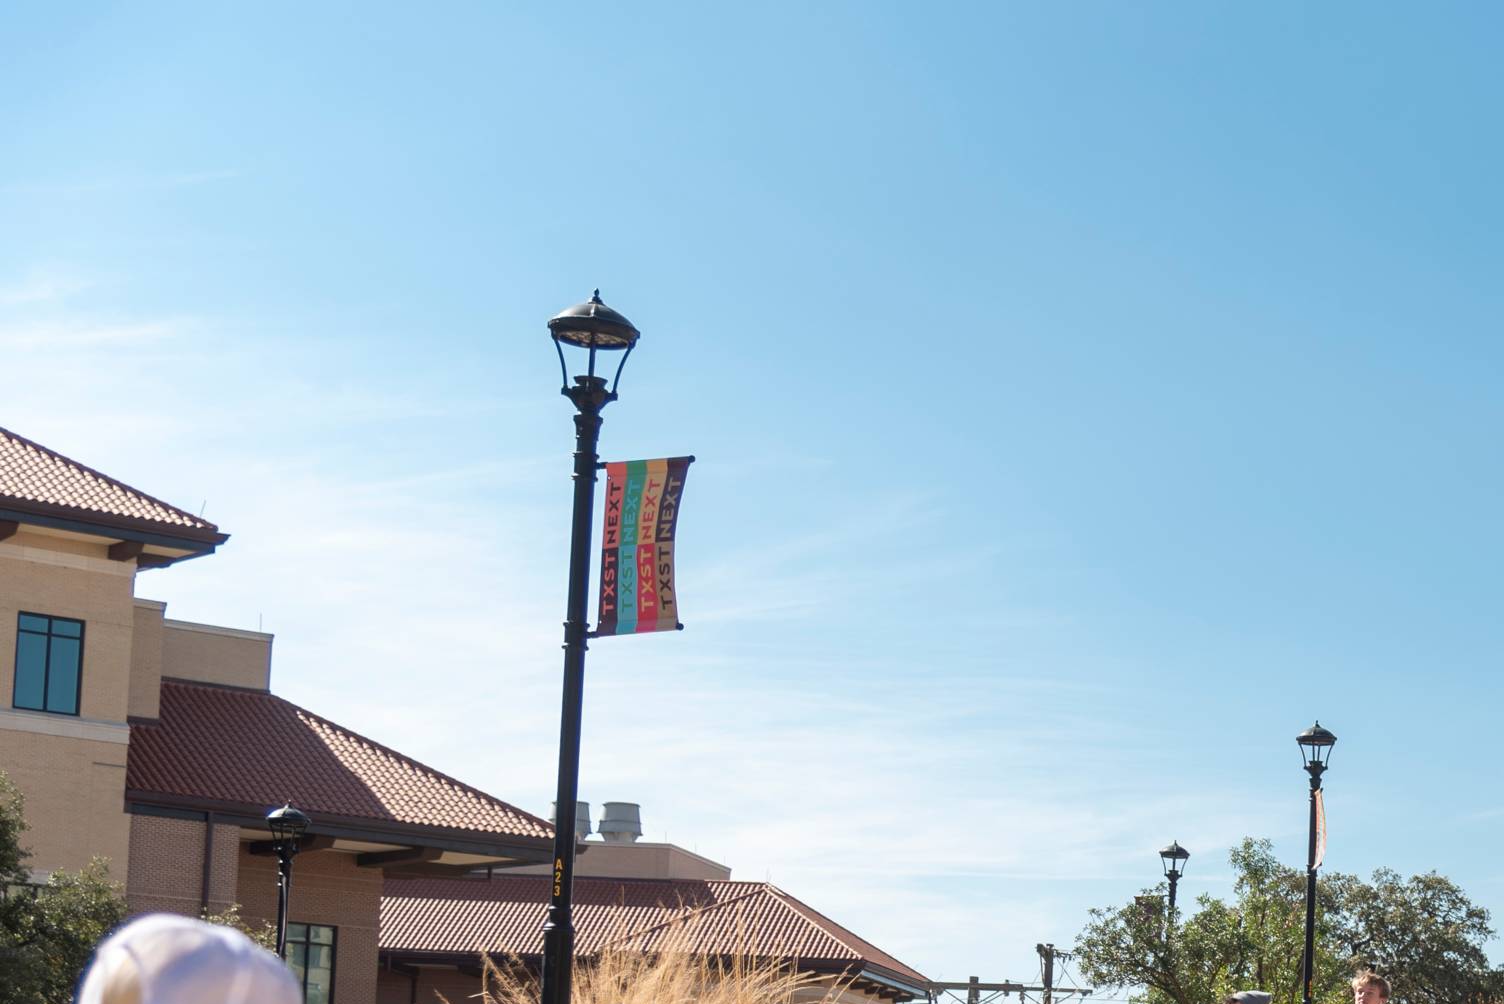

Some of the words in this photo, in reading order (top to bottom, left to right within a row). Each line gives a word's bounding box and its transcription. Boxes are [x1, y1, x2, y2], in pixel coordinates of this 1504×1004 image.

[607, 482, 622, 545] NEXT
[624, 480, 641, 542] NEXT
[642, 479, 660, 540] NEXT
[659, 477, 682, 538] NEXT
[602, 555, 617, 615] TXST
[621, 551, 633, 614] TXST
[640, 548, 655, 612] TXST
[658, 546, 673, 610] TXST
